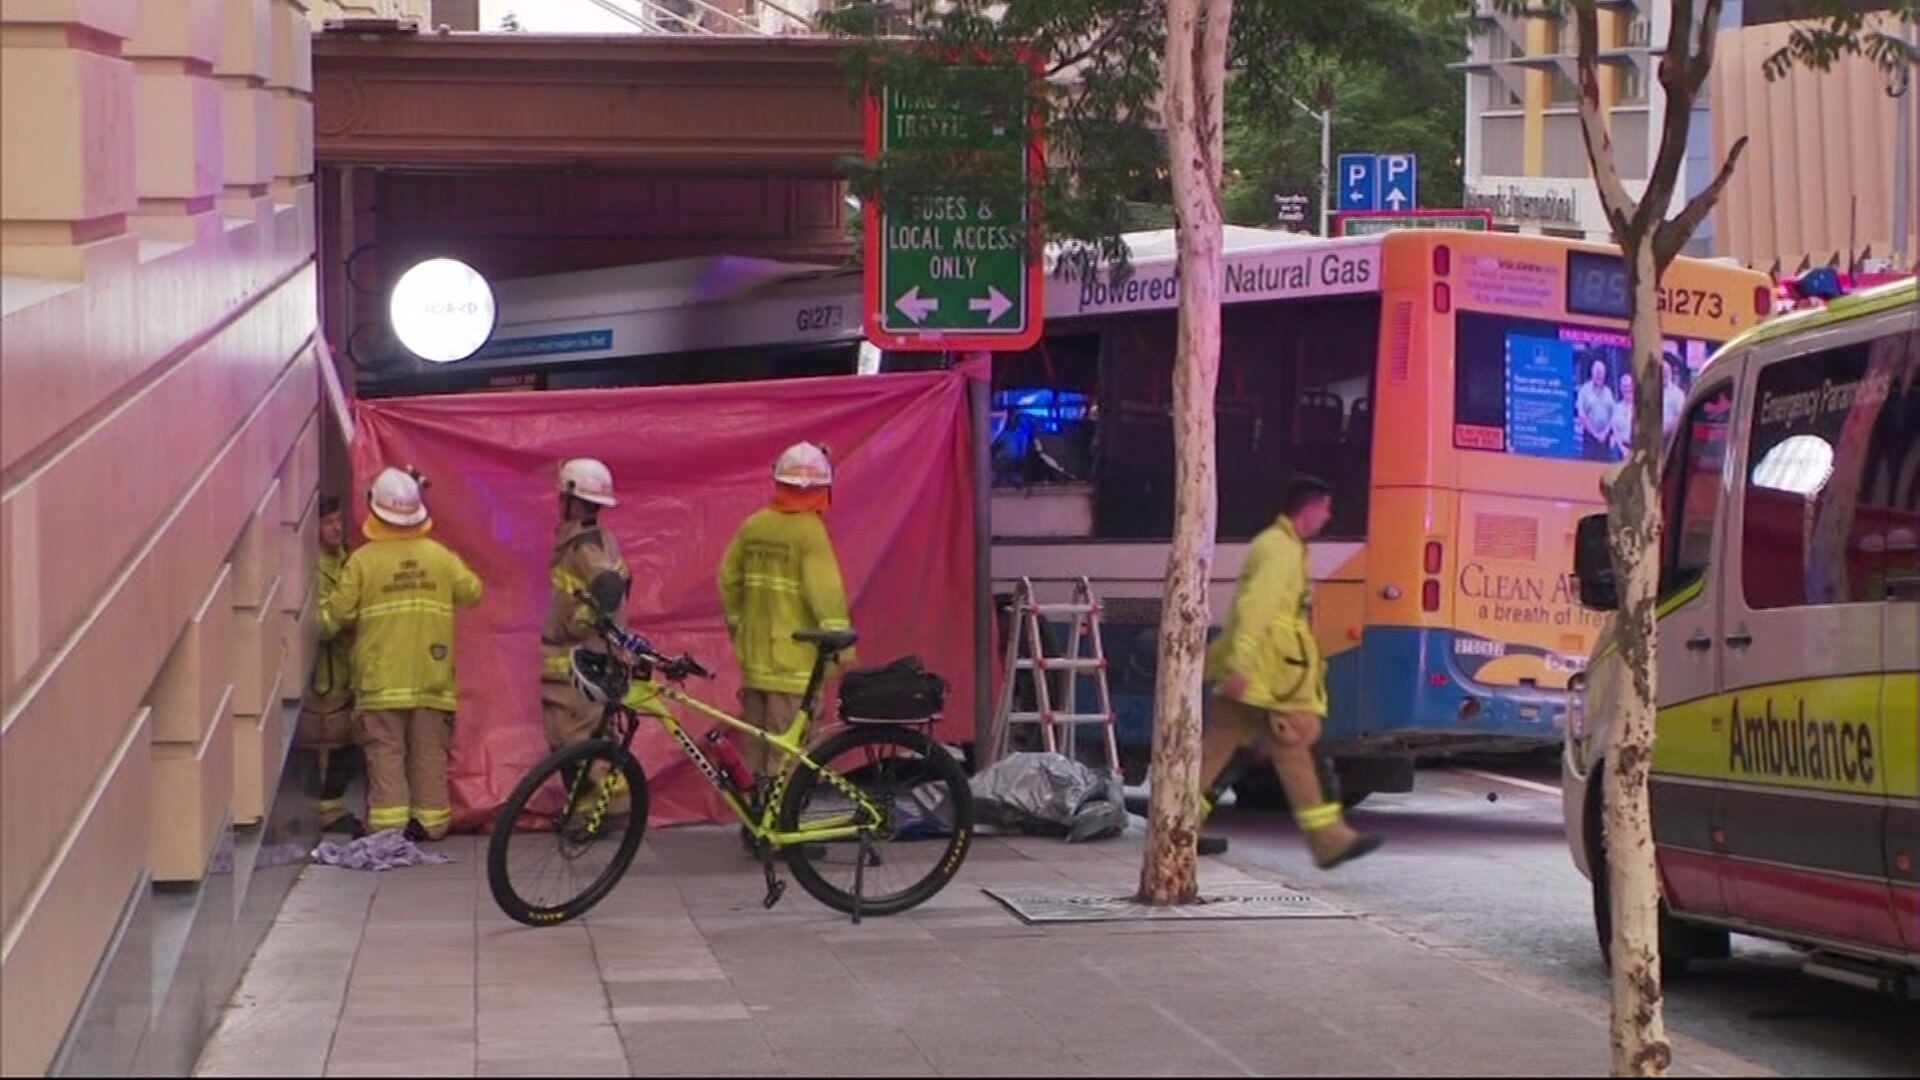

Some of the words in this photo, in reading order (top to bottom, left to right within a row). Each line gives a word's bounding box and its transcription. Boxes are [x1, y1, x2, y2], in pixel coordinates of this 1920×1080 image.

[1350, 164, 1366, 187] P
[1388, 156, 1408, 182] P
[889, 226, 944, 250] LOCAL
[930, 255, 977, 279] ONLY
[1225, 257, 1311, 293] Natural
[1320, 254, 1371, 285] Gas
[1460, 563, 1544, 600] CLEAN
[1478, 605, 1488, 620] a
[1494, 604, 1549, 625] breath
[1555, 606, 1571, 626] of
[1730, 698, 1874, 785] Ambulance
